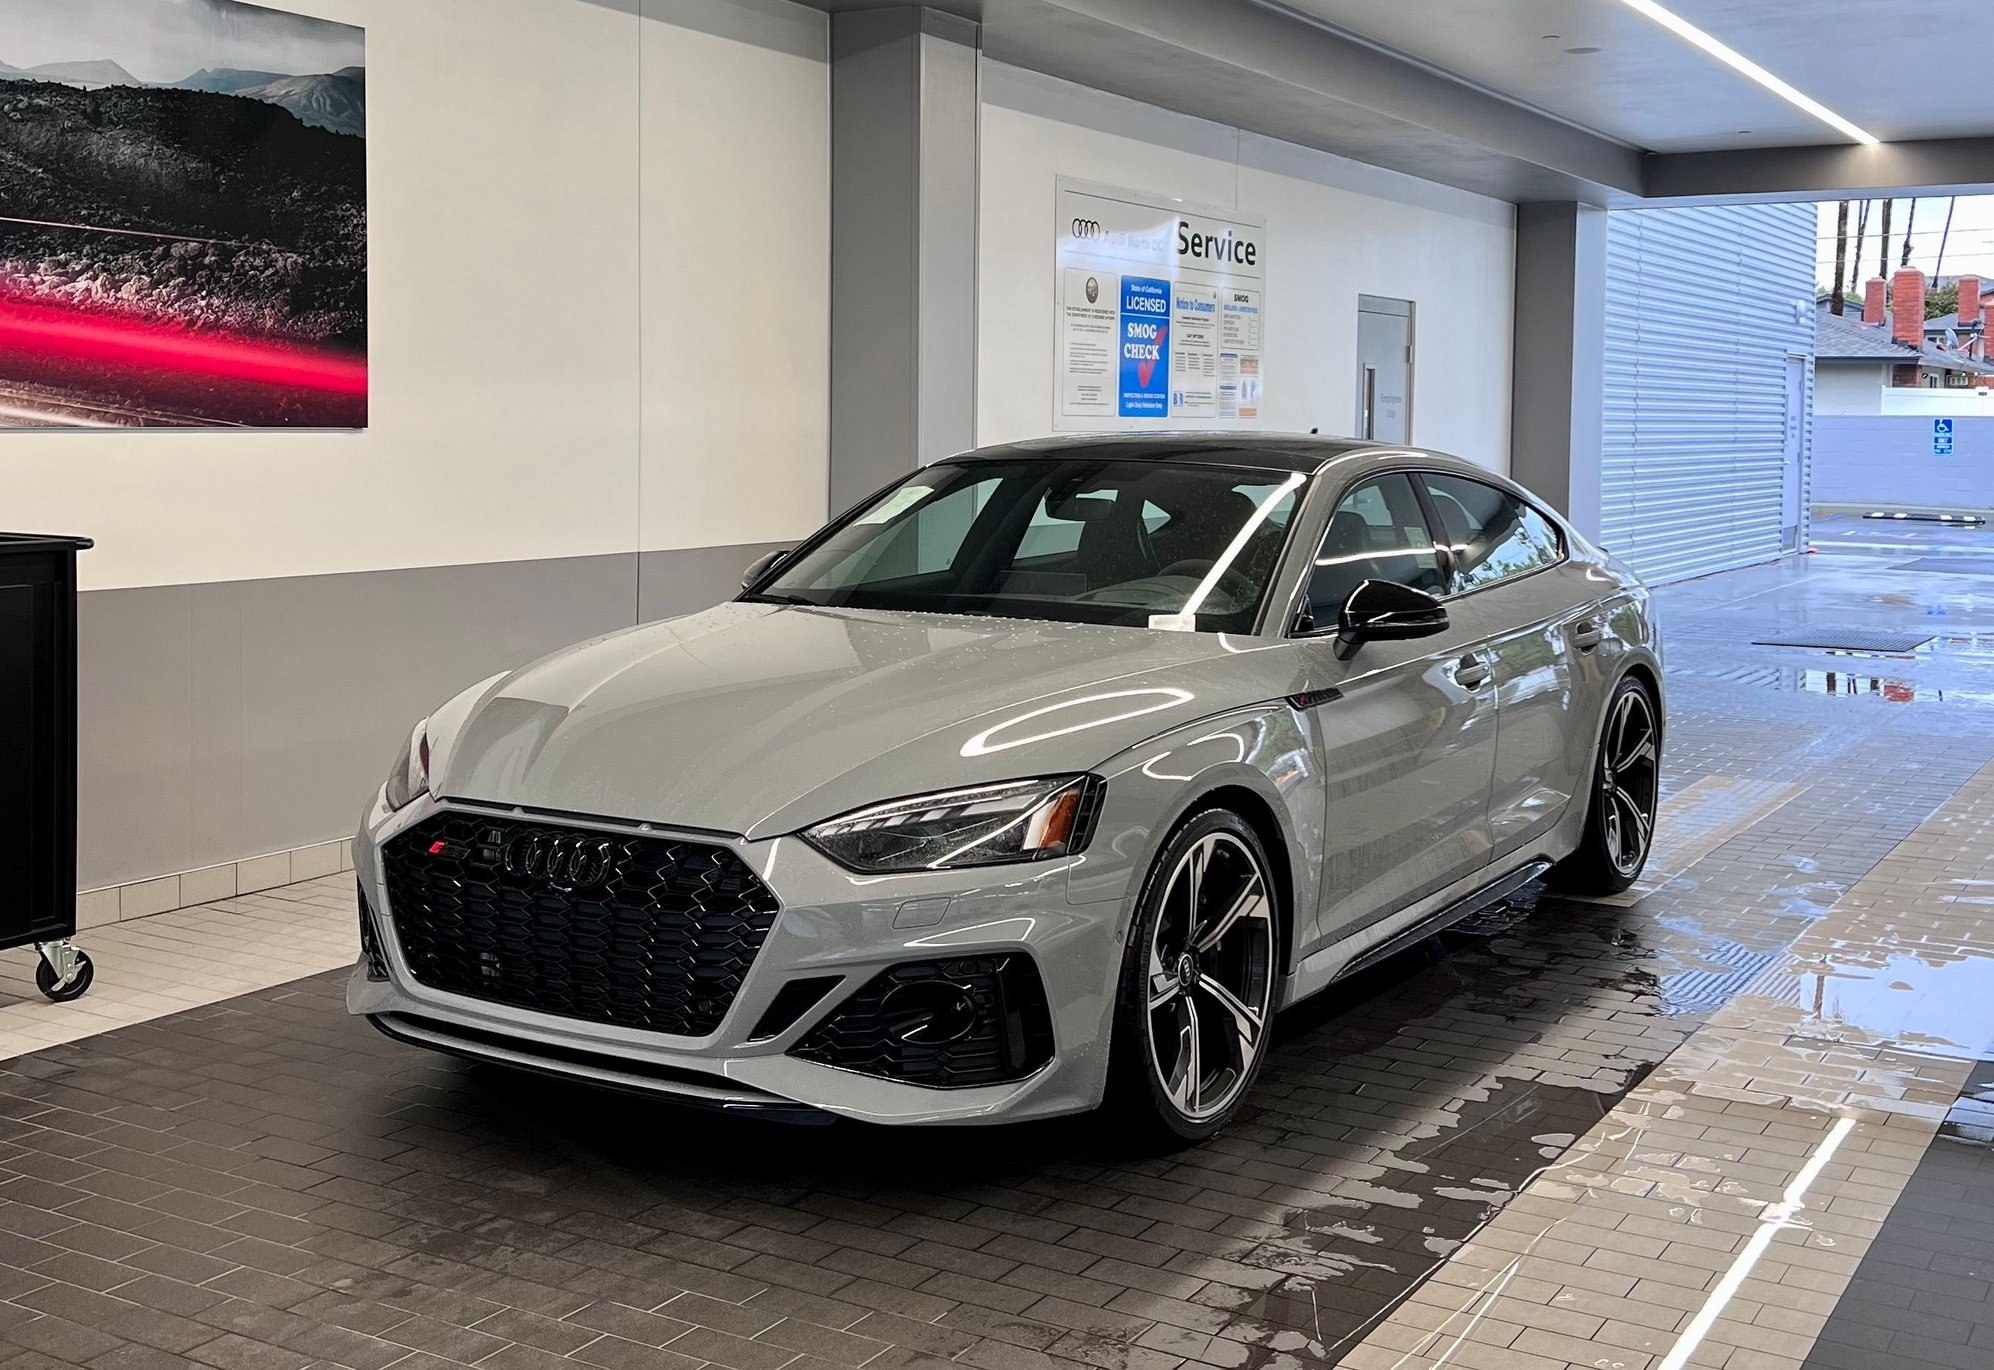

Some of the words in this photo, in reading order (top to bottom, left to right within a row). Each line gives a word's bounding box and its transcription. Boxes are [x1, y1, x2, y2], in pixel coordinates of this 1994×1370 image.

[1103, 230, 1126, 246] Audi
[1128, 235, 1151, 249] North
[1177, 221, 1257, 266] Service
[1126, 295, 1166, 313] LICENSED
[1233, 293, 1249, 303] SMOG
[1127, 322, 1157, 339] SMOG
[1124, 343, 1160, 360] CHECK
